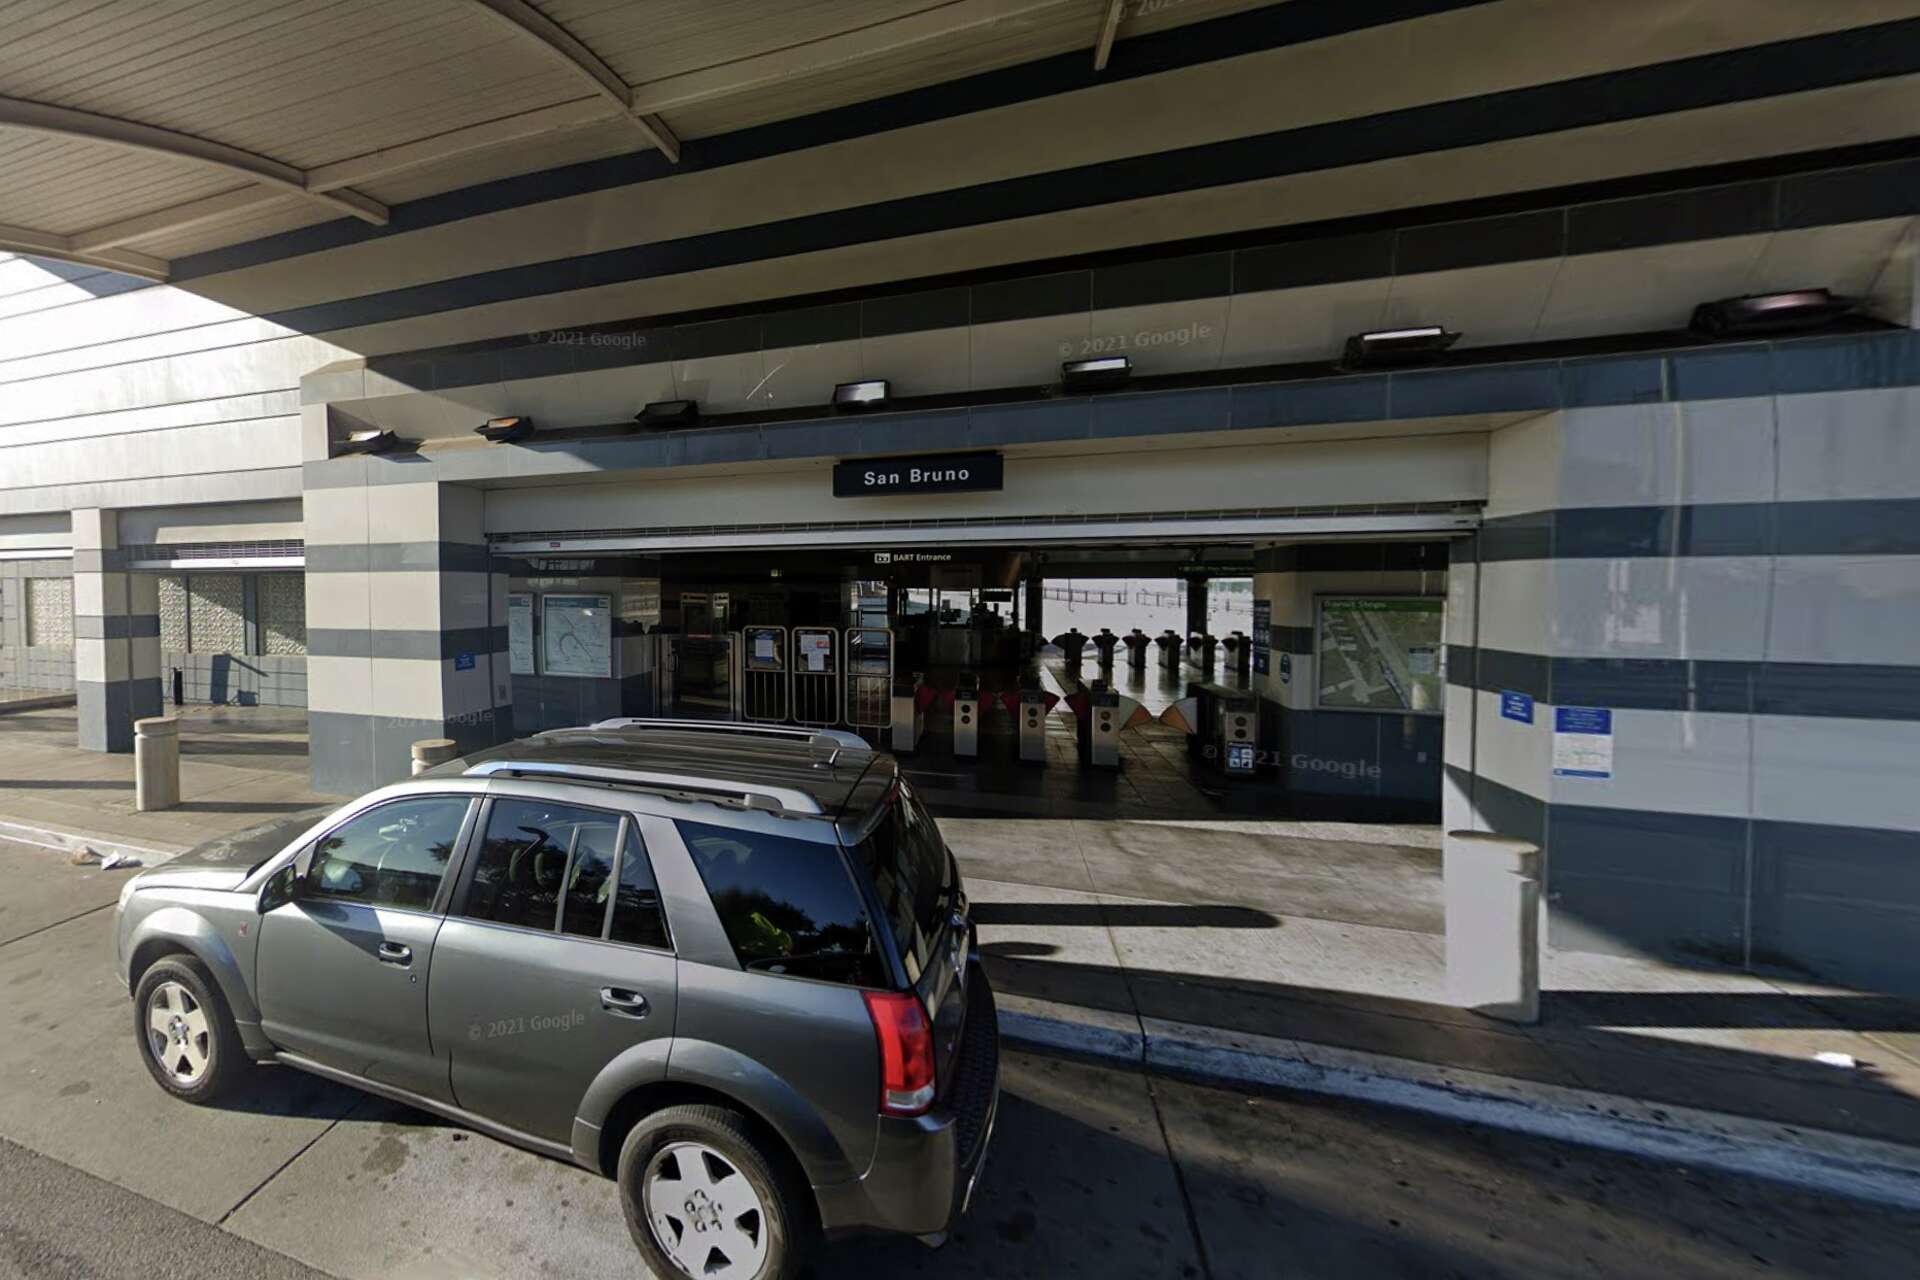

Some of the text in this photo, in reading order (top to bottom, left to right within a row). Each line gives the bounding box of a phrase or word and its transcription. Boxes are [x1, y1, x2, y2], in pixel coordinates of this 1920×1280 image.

[864, 468, 969, 485] San Bruno
[893, 553, 952, 562] BART Entrance
